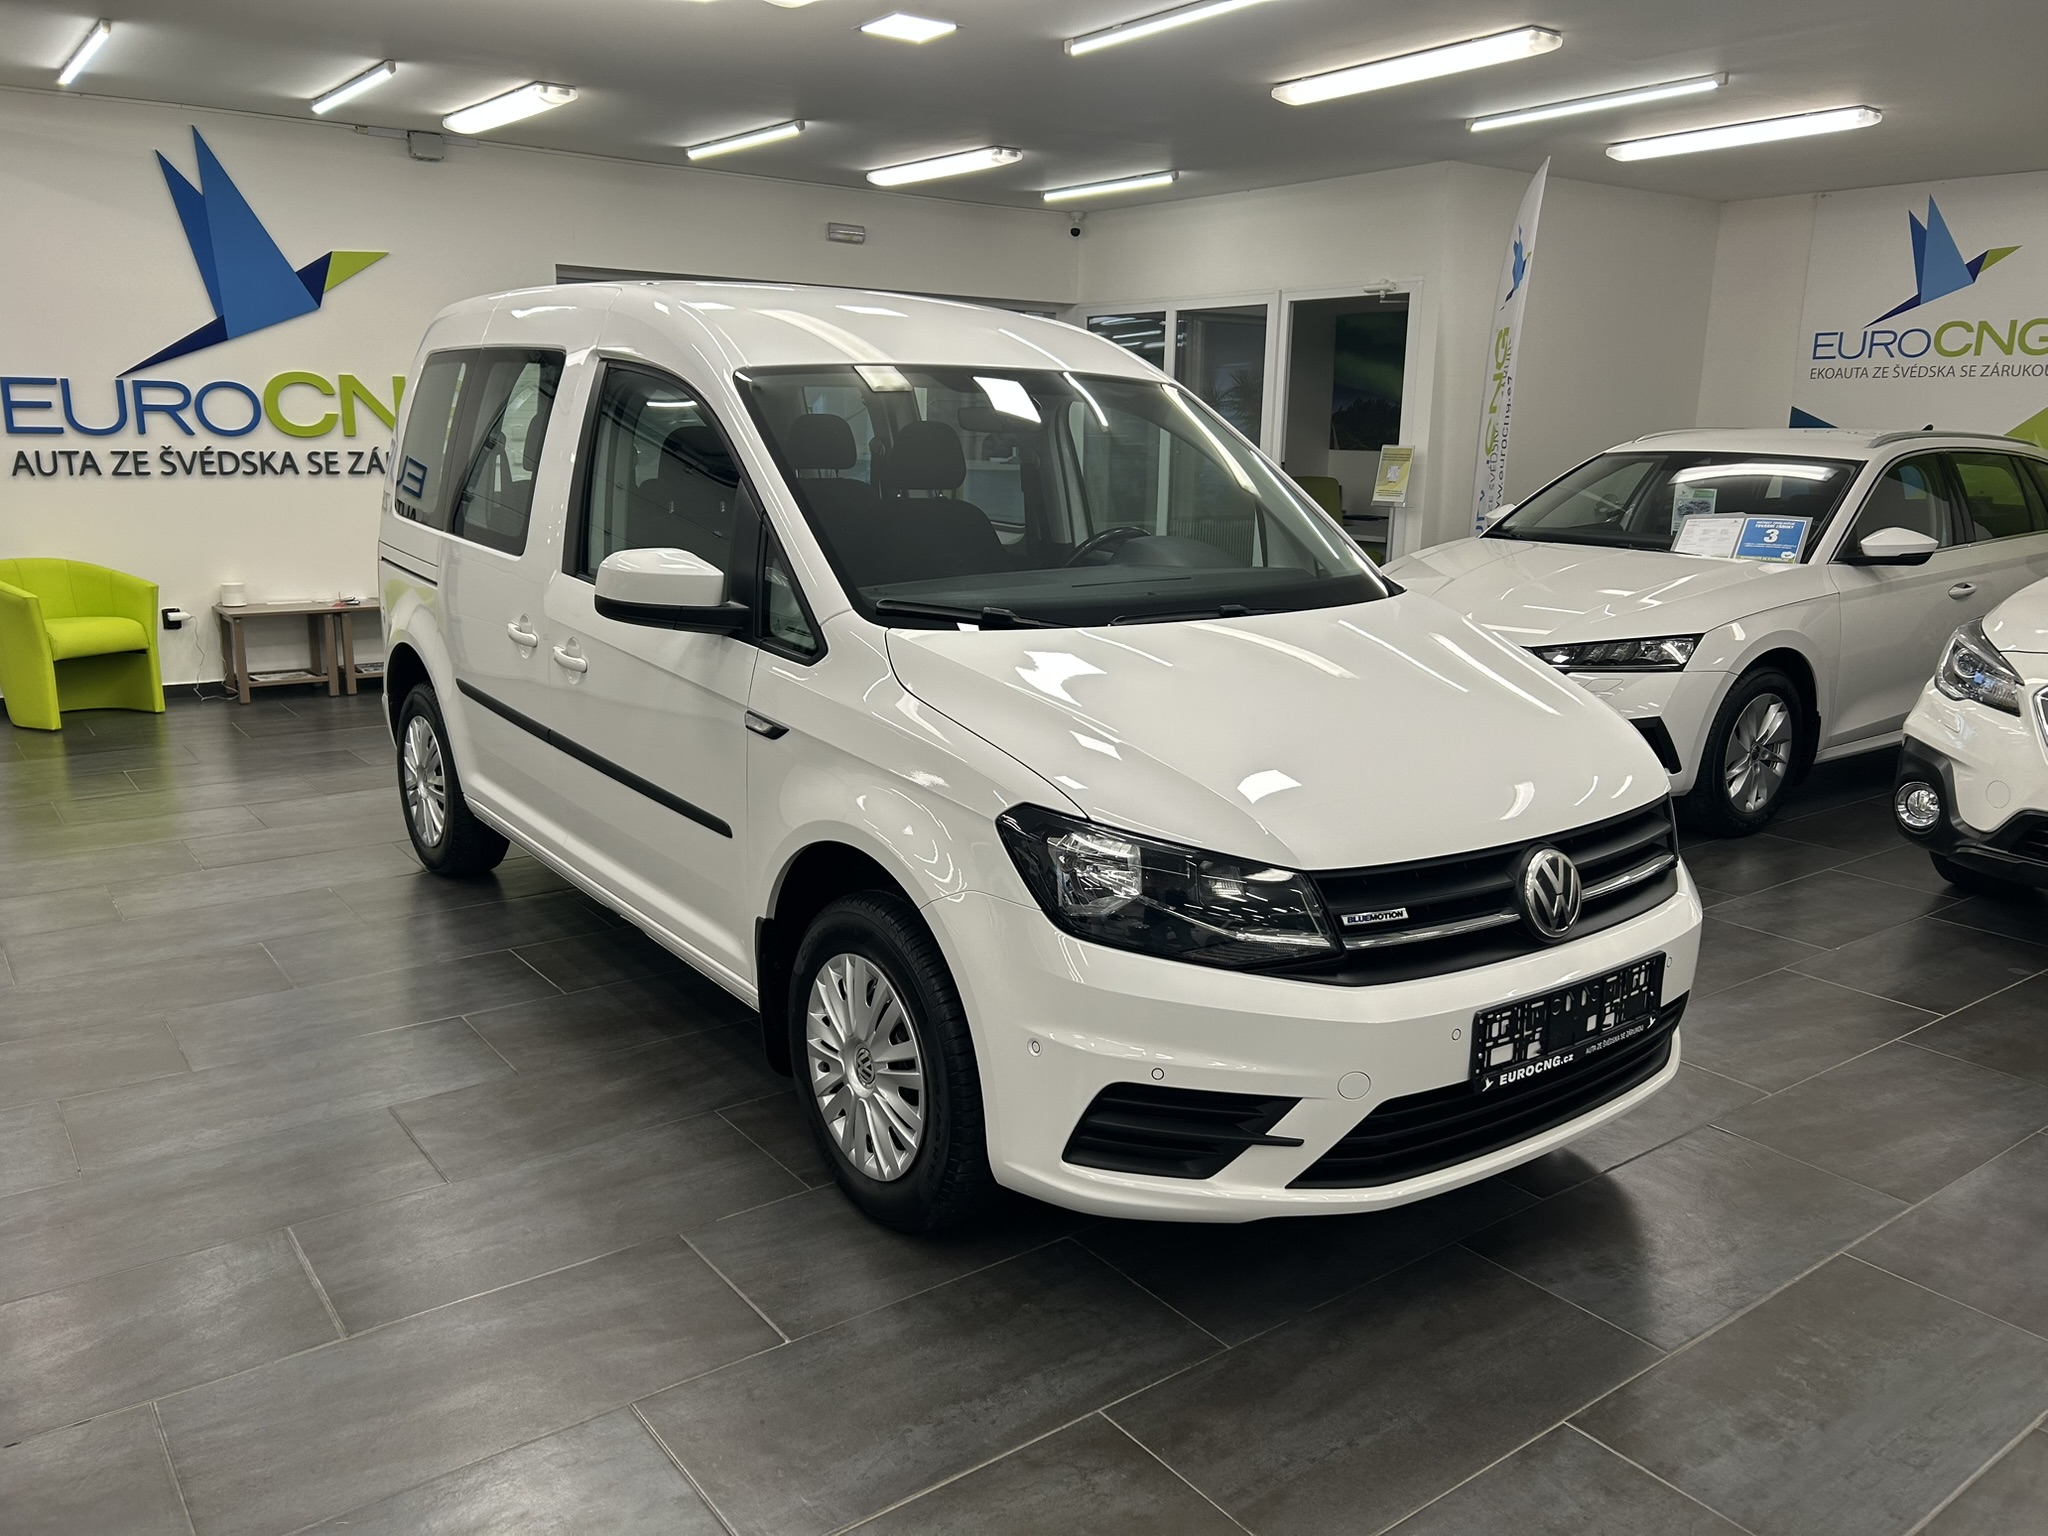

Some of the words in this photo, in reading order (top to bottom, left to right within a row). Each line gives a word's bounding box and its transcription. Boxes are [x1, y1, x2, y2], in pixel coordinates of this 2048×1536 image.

[1812, 317, 2048, 360] EUROCNG
[1809, 366, 1869, 380] EKOAUTA
[1872, 366, 1890, 379] ZE
[1892, 363, 1956, 379] ŠVÉDSKA
[1960, 364, 1977, 378] SE
[12, 450, 102, 477] AUTA
[111, 450, 151, 476] ZE
[160, 445, 300, 476] ŠVÉDSKA
[308, 450, 339, 475] SE
[348, 446, 389, 475] ZÁ
[1763, 528, 1780, 543] 3
[1346, 910, 1404, 925] BLUEMOTION
[1585, 1044, 1597, 1055] AUTA
[1499, 1053, 1574, 1087] EUROCNG.cz
